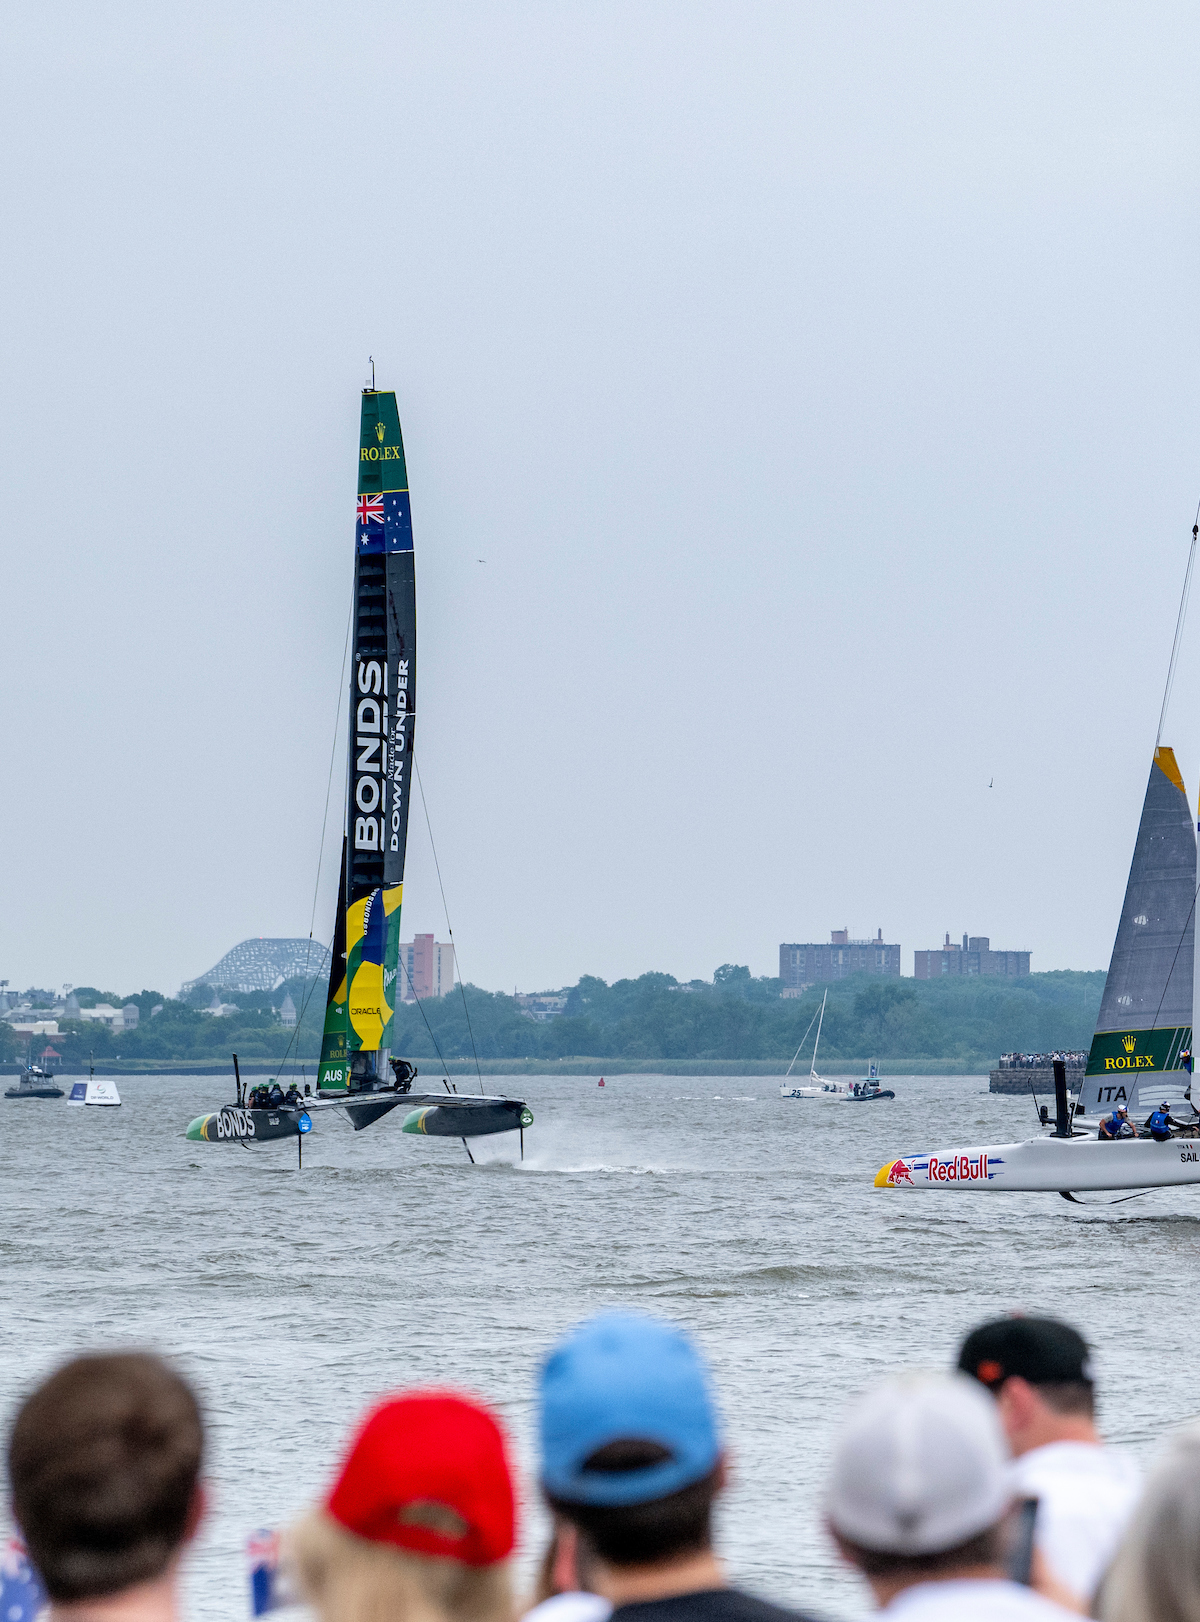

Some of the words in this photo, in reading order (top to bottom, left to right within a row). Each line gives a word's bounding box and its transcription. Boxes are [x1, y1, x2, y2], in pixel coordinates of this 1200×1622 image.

[360, 445, 401, 461] ROLEX
[394, 659, 410, 752] UNDER
[388, 727, 396, 746] for
[354, 660, 382, 851] BONDS
[387, 747, 396, 781] Made
[390, 760, 404, 852] DOWN
[351, 1007, 381, 1015] ORACLE
[330, 1048, 347, 1059] ROLE
[1104, 1055, 1154, 1070] ROLEX
[323, 1069, 343, 1082] AUS
[791, 1089, 801, 1097] 25
[1097, 1086, 1128, 1103] ITA
[217, 1110, 255, 1138] BONDS
